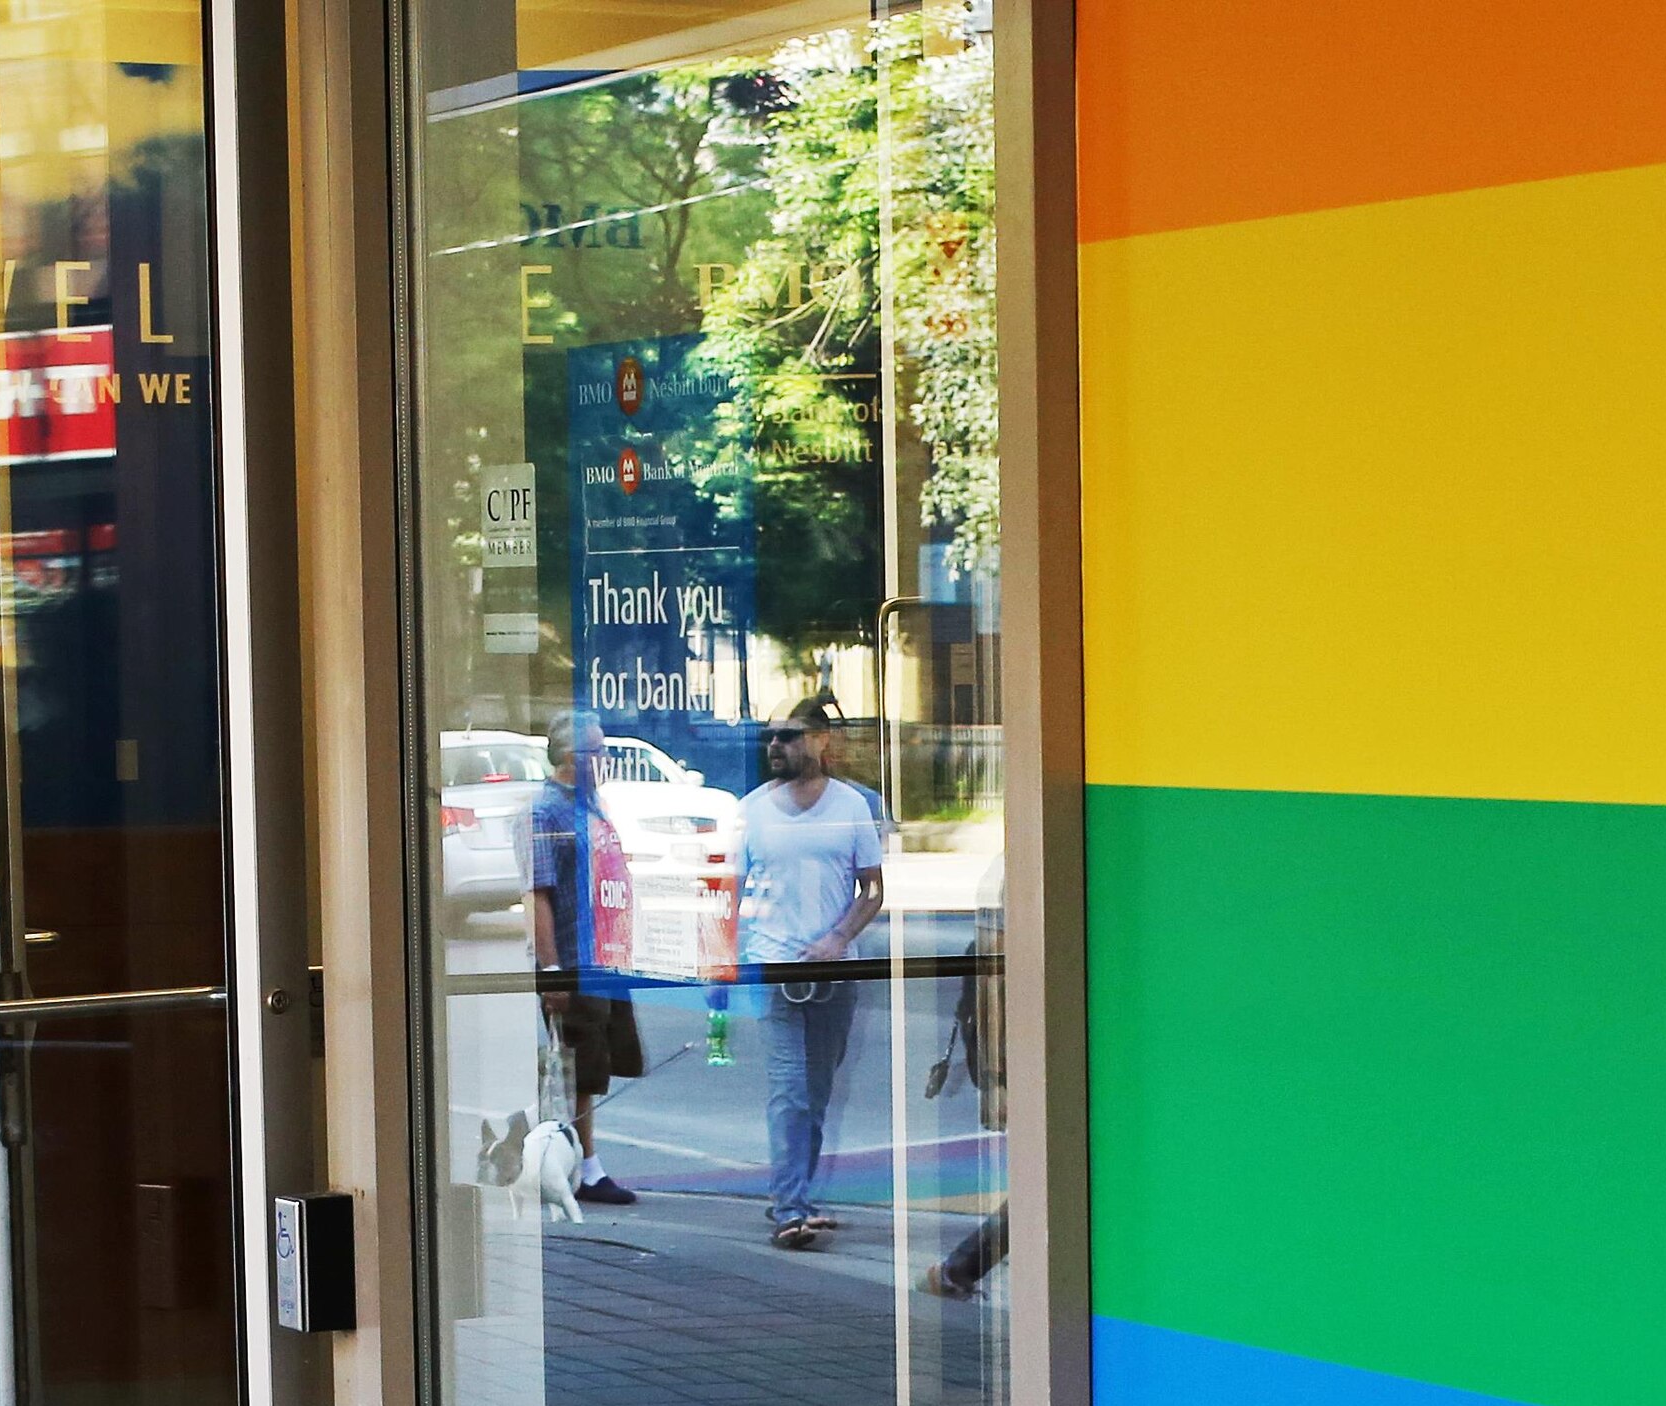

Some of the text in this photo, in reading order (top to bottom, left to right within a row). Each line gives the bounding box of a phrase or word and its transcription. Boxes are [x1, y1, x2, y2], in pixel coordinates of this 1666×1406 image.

[139, 373, 191, 404] WE
[579, 382, 612, 405] BMO
[649, 374, 695, 399] Nesbitt
[586, 467, 615, 484] BMO
[643, 460, 671, 480] Bank
[488, 541, 532, 556] MEMBER
[589, 570, 724, 637] Thank you
[590, 656, 627, 709] for
[600, 880, 627, 910] CDIC
